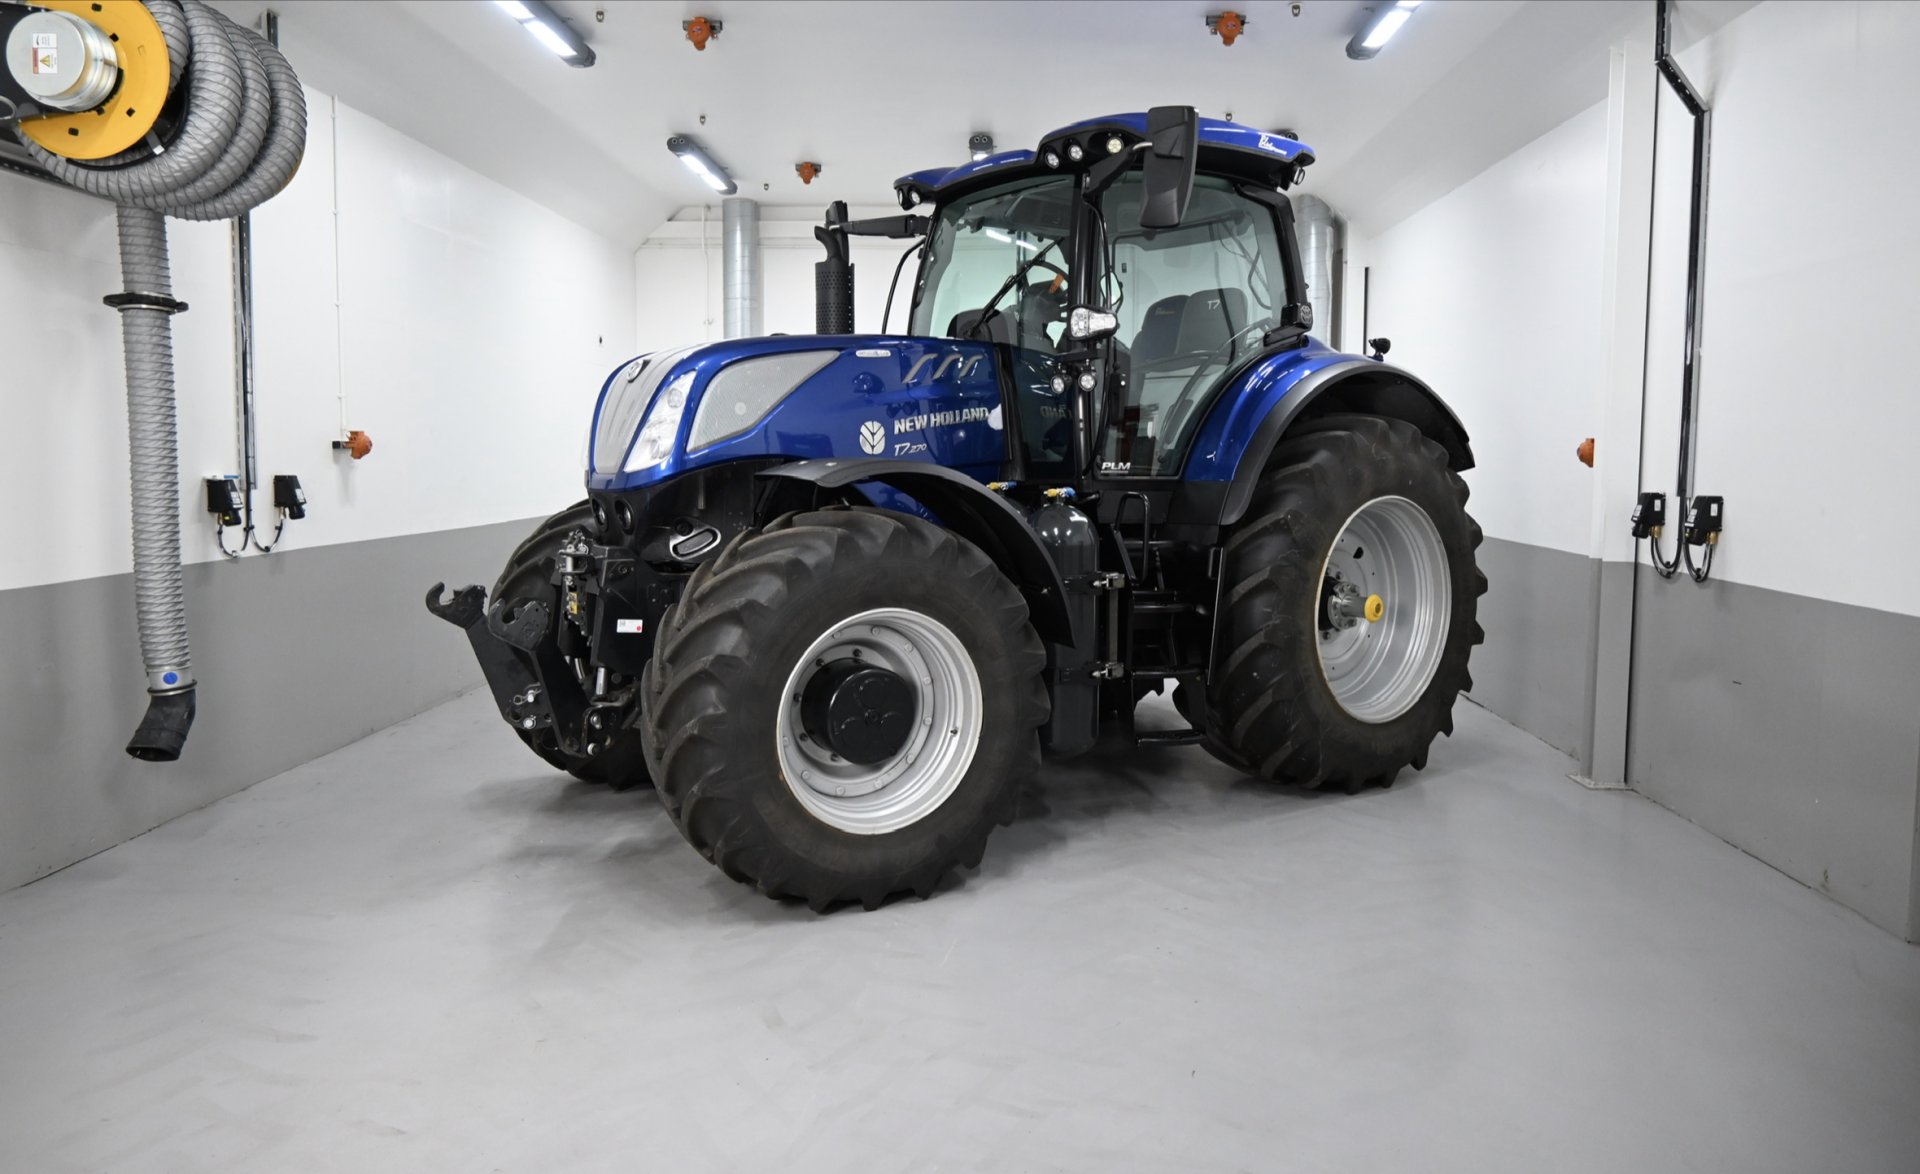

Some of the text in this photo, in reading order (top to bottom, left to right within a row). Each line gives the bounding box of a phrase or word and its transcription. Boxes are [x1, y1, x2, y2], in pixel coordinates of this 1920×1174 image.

[1207, 298, 1221, 310] T7
[894, 407, 989, 435] NEW HOLLAND
[1101, 461, 1131, 470] PLM
